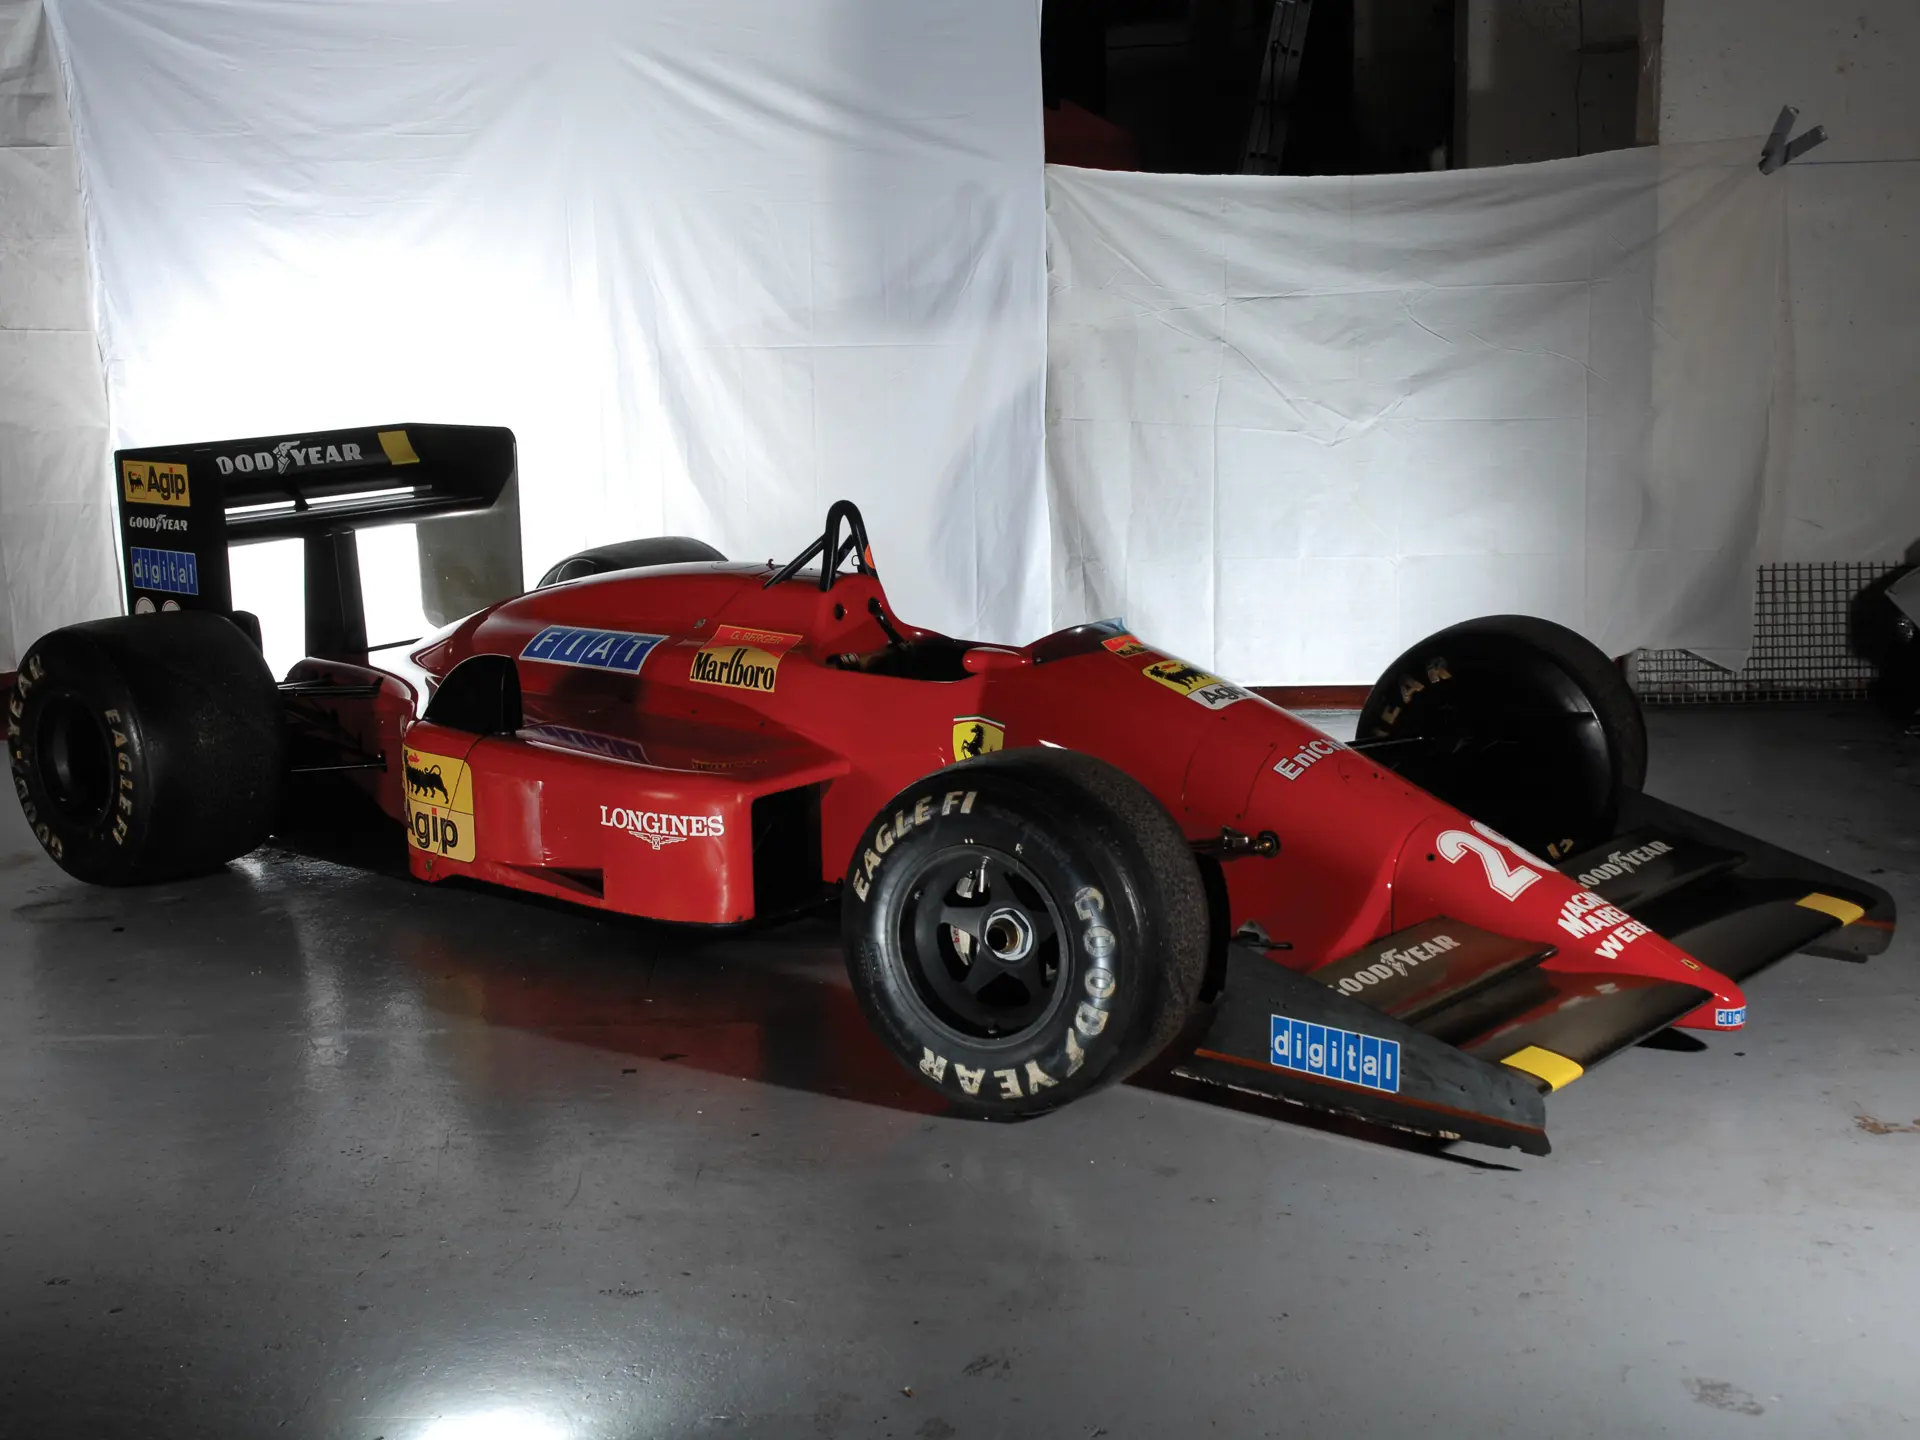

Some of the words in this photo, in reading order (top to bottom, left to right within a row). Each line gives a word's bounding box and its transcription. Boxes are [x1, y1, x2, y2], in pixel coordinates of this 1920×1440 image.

[147, 466, 186, 500] Agip
[133, 559, 193, 584] digital
[532, 631, 651, 663] FIAT
[742, 632, 784, 644] BERGER
[690, 648, 775, 690] Marlboro
[104, 709, 133, 816] EAGLE
[600, 805, 725, 836] LONGINES
[852, 796, 932, 902] EAGLE
[1579, 841, 1673, 889] OODYEAR
[1273, 1030, 1392, 1080] digital
